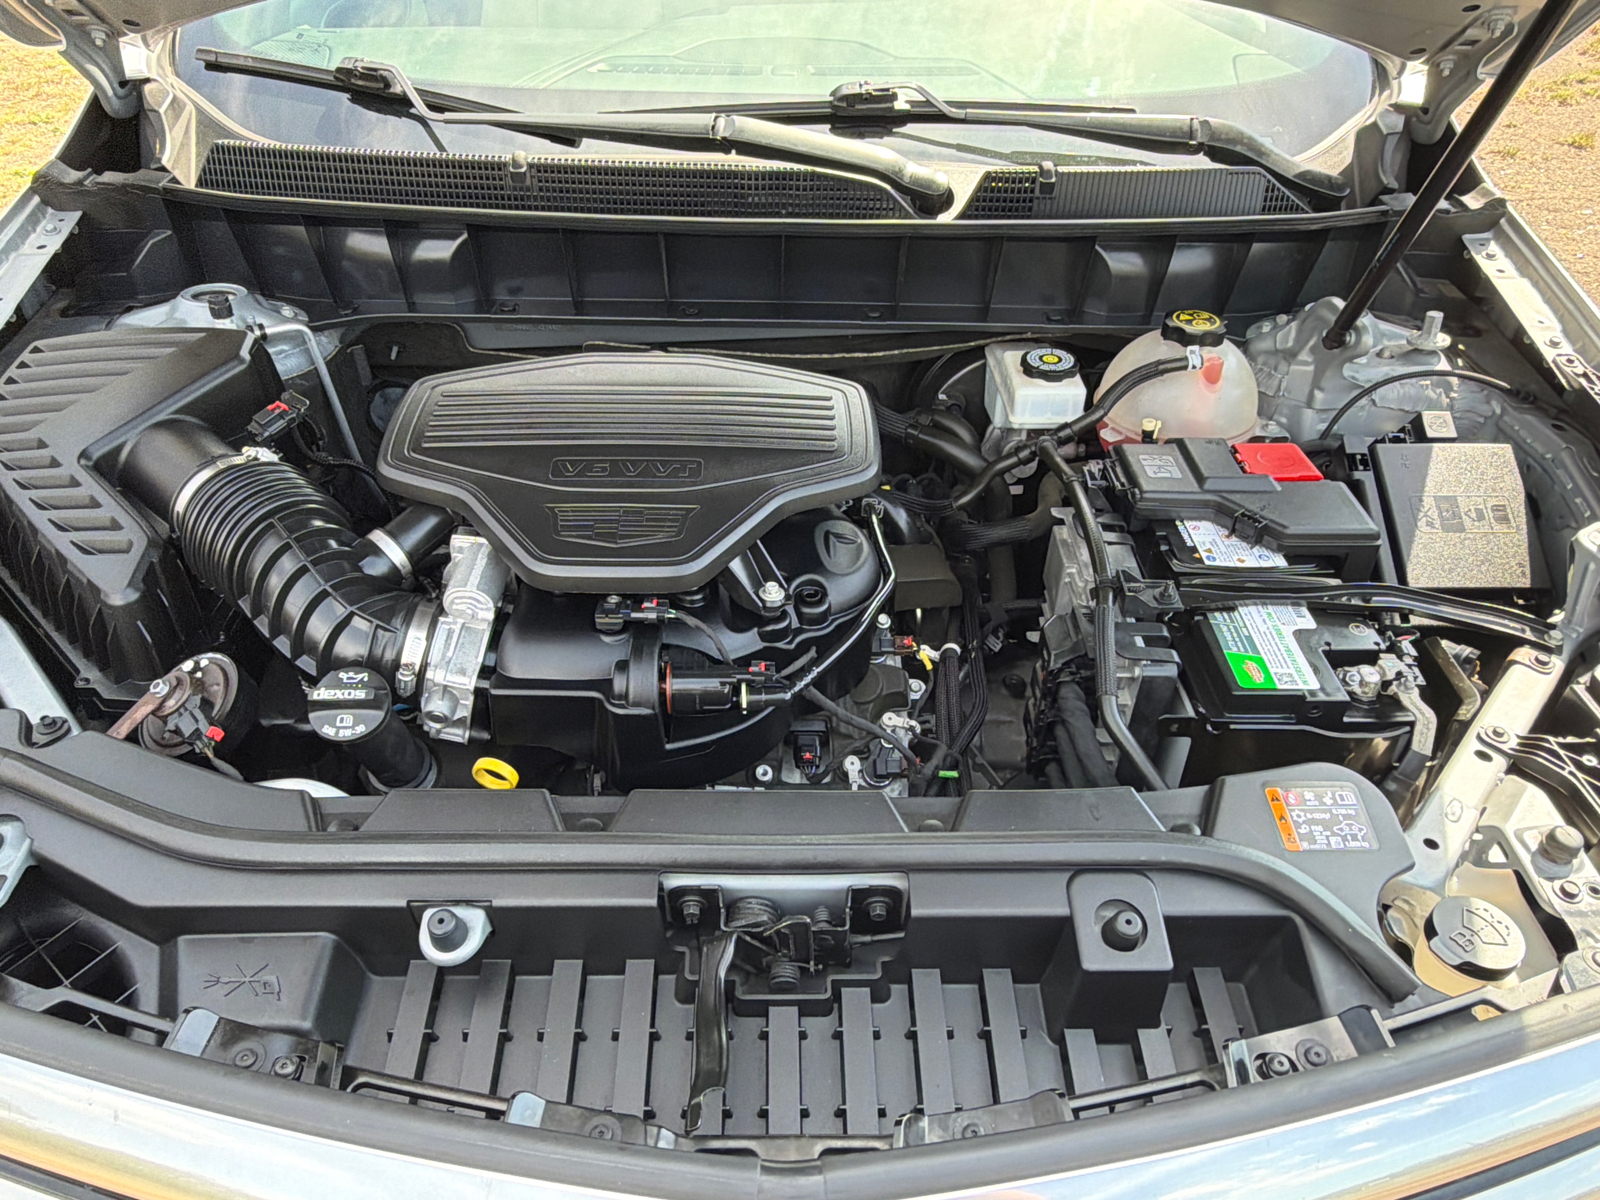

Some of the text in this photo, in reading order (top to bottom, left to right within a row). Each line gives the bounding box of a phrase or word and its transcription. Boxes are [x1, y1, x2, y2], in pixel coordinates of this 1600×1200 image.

[312, 687, 368, 700] dexos
[321, 724, 366, 737] SAE 5W-30
